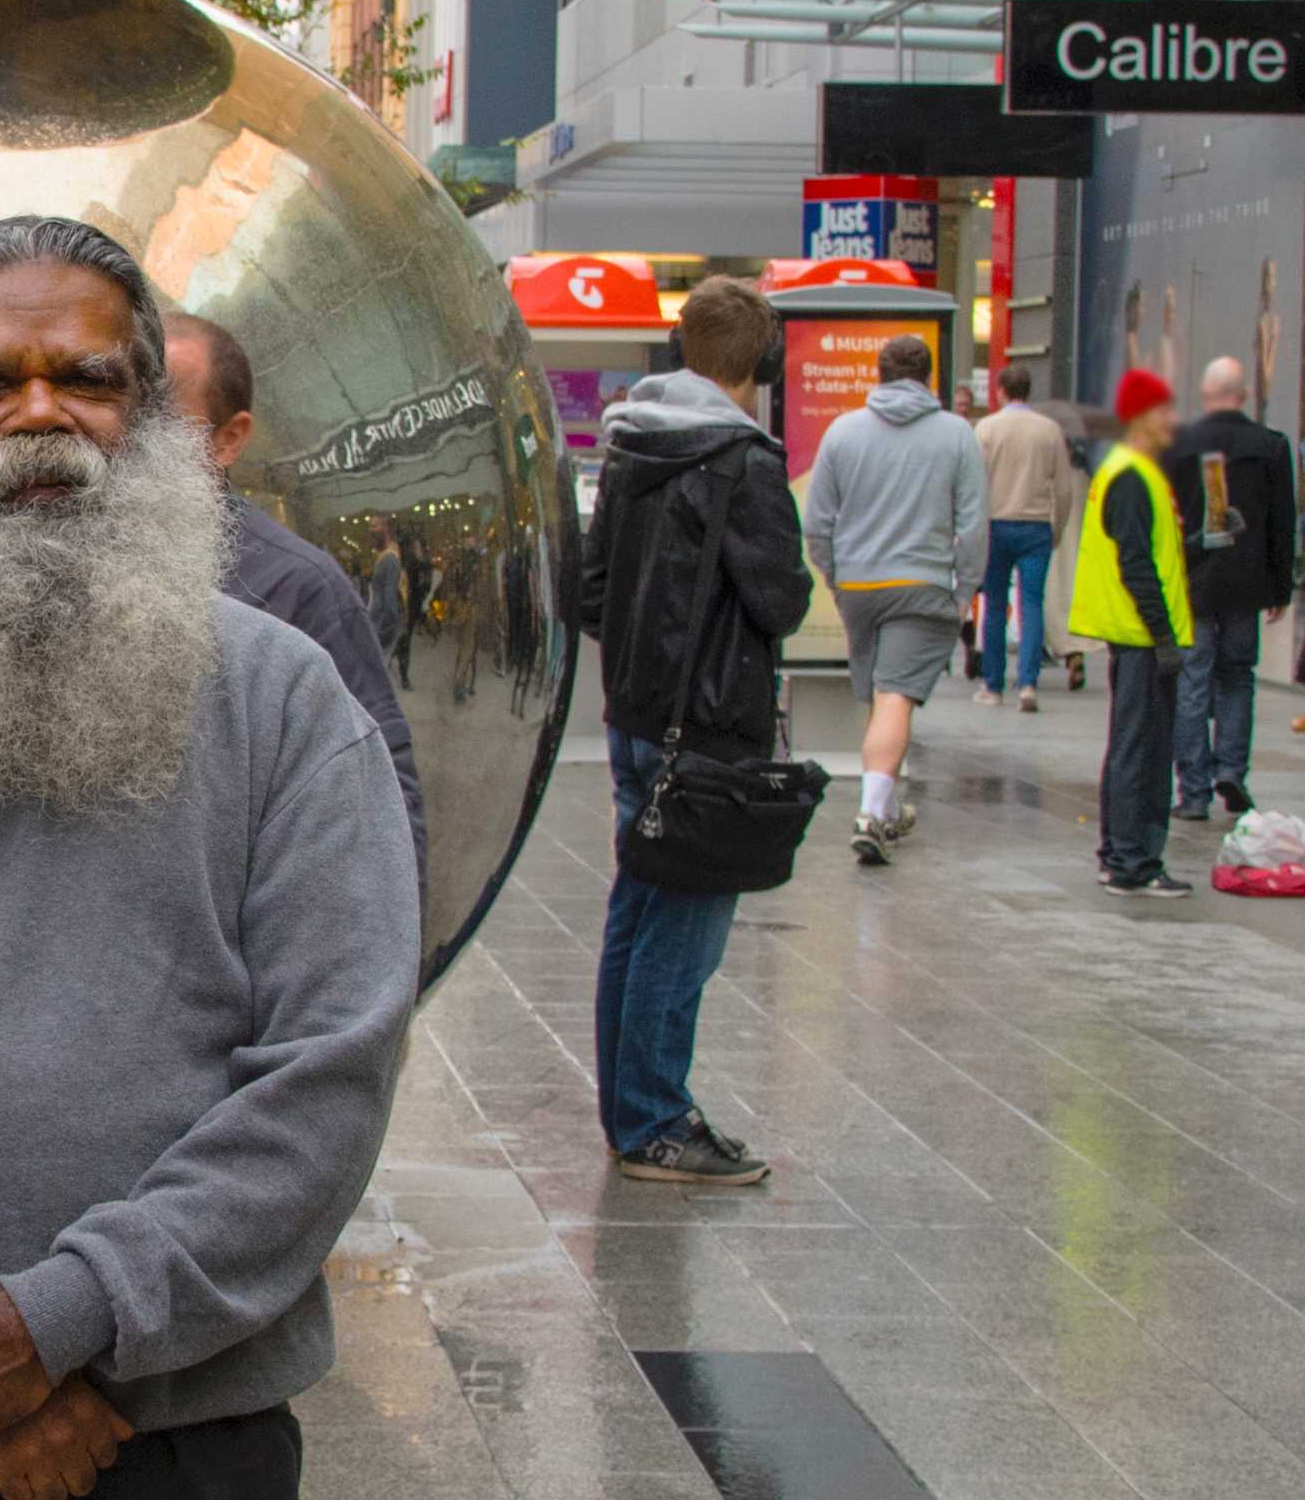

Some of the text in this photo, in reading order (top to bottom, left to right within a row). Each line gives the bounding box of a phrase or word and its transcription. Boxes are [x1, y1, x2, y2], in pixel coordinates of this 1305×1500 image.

[1056, 20, 1288, 83] Calibre
[816, 201, 868, 238] Just
[895, 202, 930, 235] Just
[811, 231, 875, 259] Jeans
[888, 229, 935, 265] Jeans
[802, 362, 855, 378] Stream
